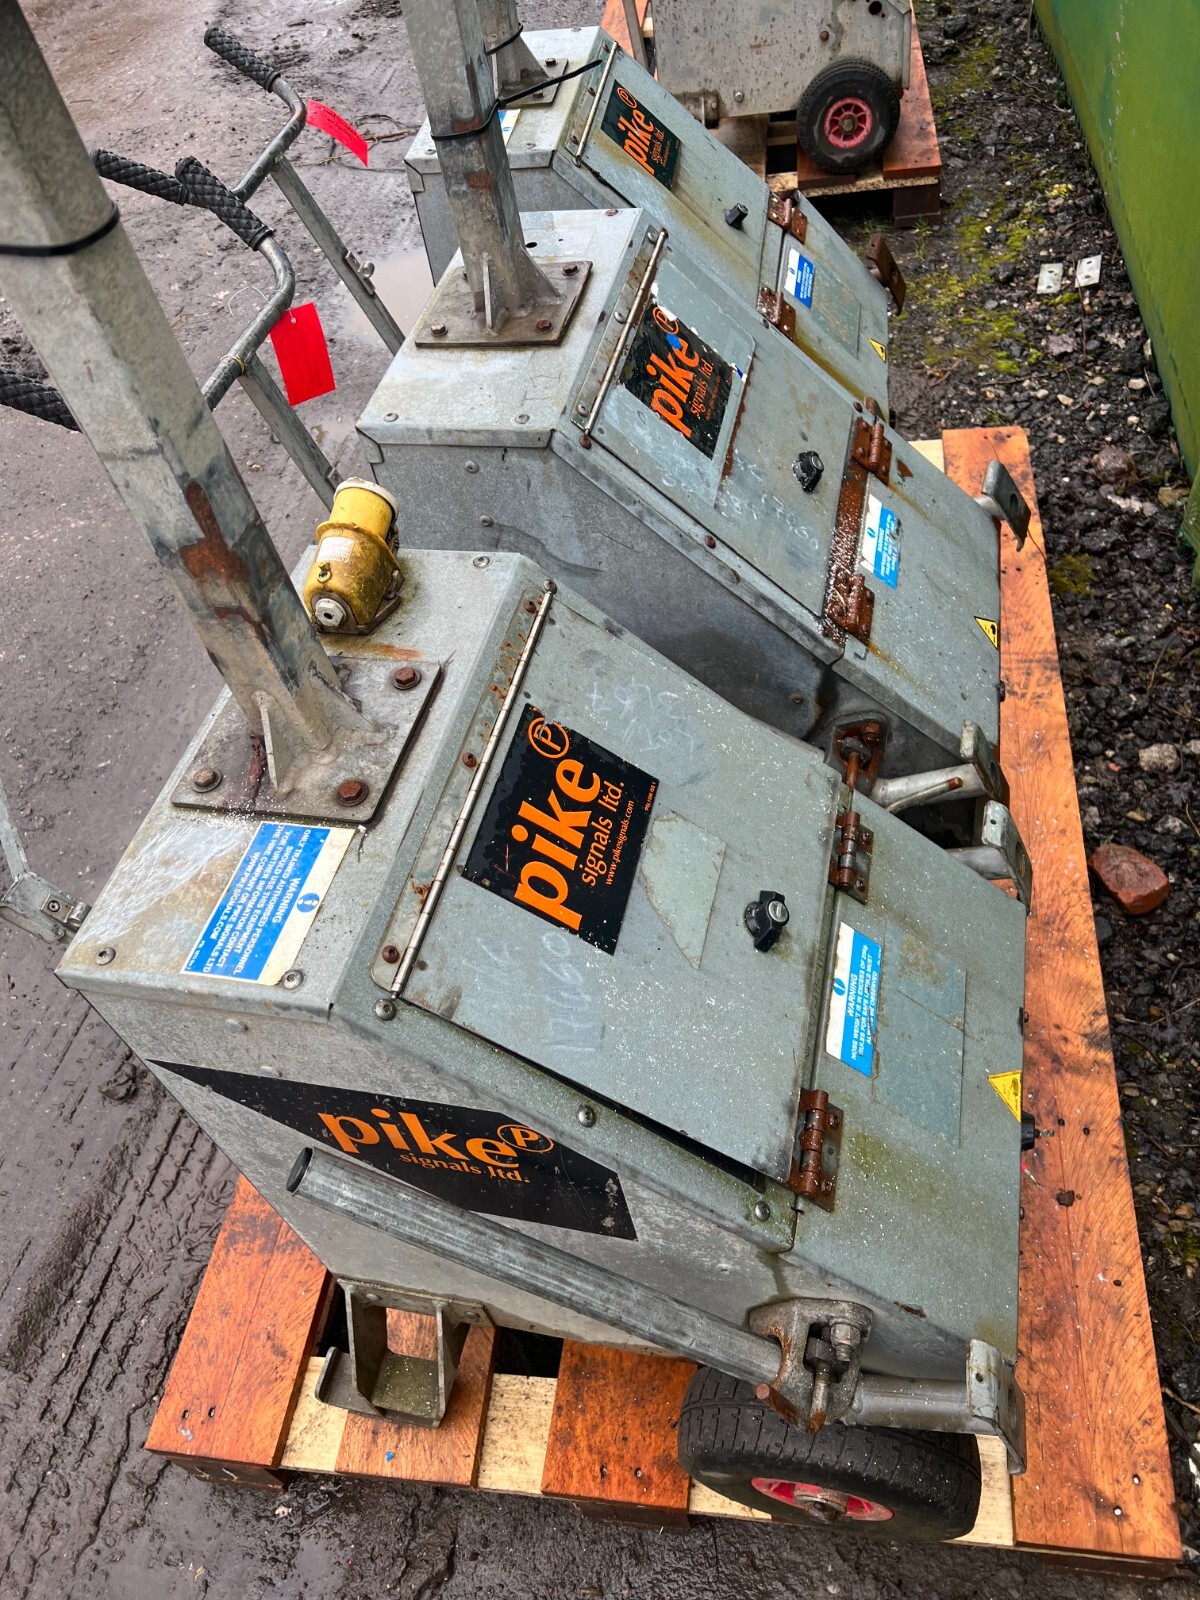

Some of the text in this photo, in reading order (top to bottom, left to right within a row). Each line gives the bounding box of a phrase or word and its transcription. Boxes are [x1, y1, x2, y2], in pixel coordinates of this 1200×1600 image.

[617, 109, 655, 175] pike
[646, 335, 699, 438] pike
[690, 378, 709, 417] signals
[511, 758, 601, 931] pike
[578, 781, 625, 887] signals ltd.
[605, 800, 635, 886] www.pikesignals.com
[202, 825, 284, 972] THE HIRE COMPANY OR PIKE SIGNALS LTD
[208, 852, 261, 939] WWW.PIKESIGNALS.COM
[214, 831, 290, 967] FOR FURTHER INFORMATION CONTACT
[232, 845, 293, 953] SHOULD USE THIS EQUIPMENT
[232, 829, 311, 974] ONLY TRAINED AUTHORISED PERSONNEL
[270, 877, 301, 923] WARNING
[847, 972, 857, 1017] WARNING
[860, 958, 865, 969] OF
[869, 970, 877, 1006] OBSERVED
[856, 995, 861, 1003] IN
[856, 1003, 861, 1012] IS
[317, 1108, 519, 1168] pike
[399, 1152, 531, 1183] signals ltd.
